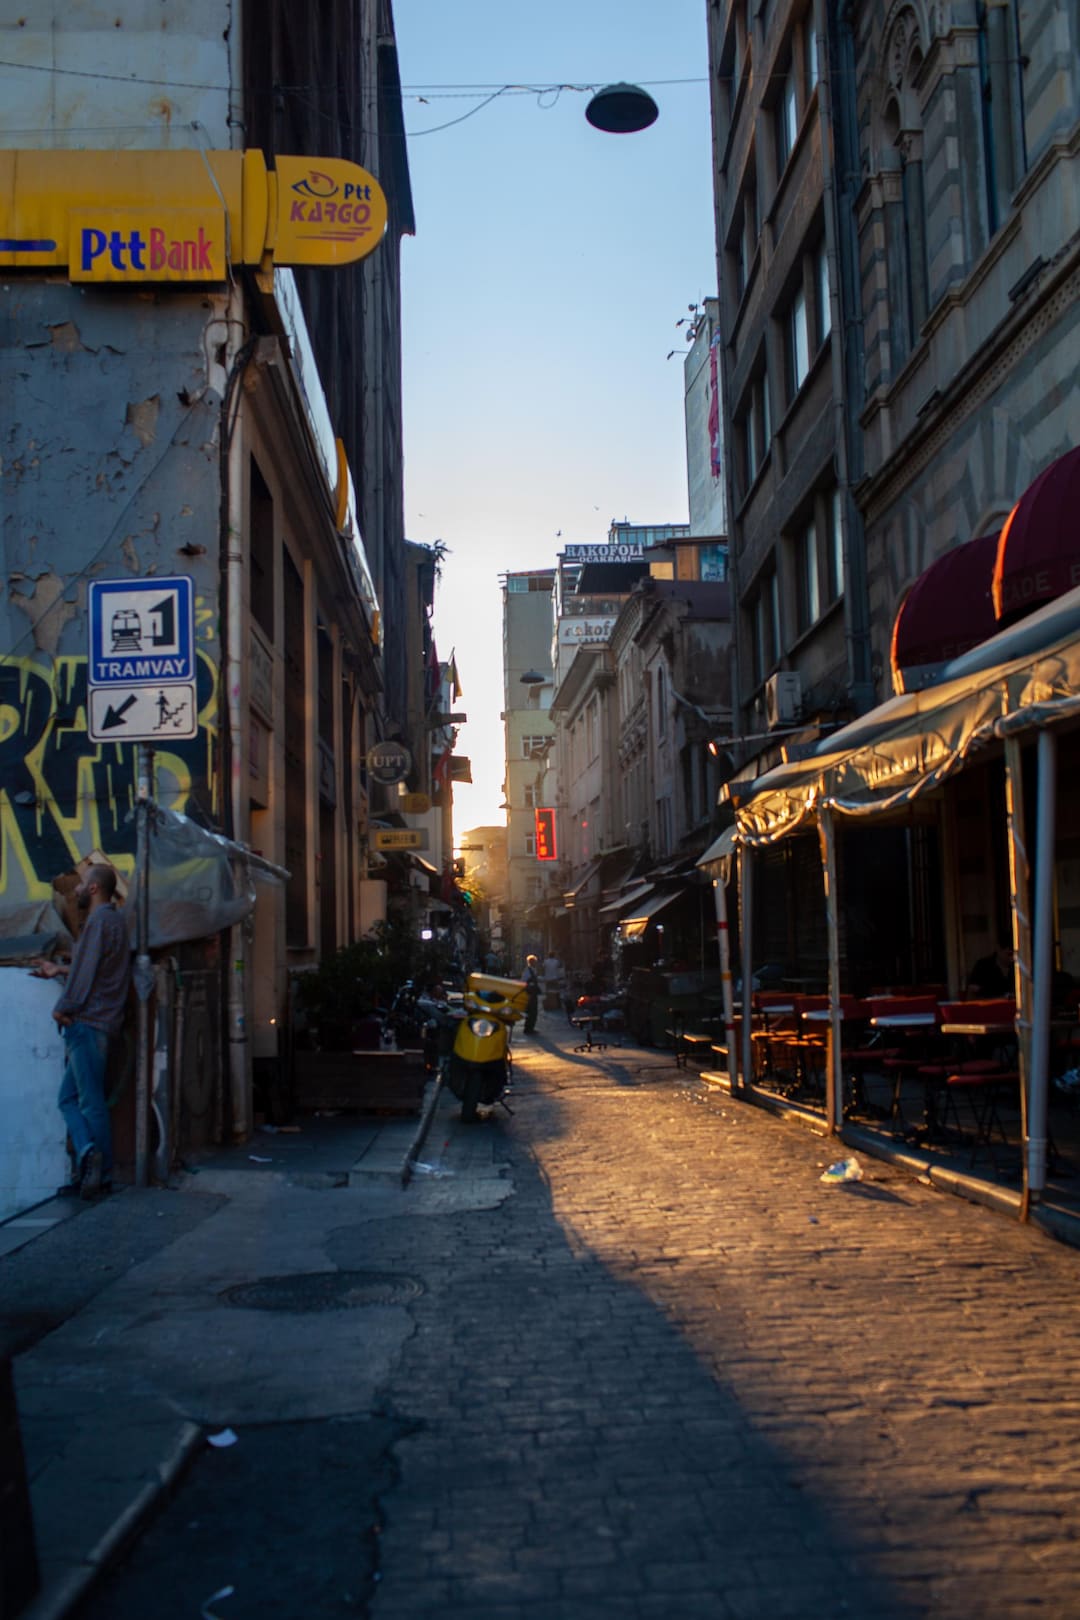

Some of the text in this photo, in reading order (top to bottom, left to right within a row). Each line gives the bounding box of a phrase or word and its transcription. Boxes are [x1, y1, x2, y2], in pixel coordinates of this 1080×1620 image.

[343, 182, 372, 200] Ptt
[289, 201, 371, 225] KARGO
[97, 658, 187, 680] TRAMVAY
